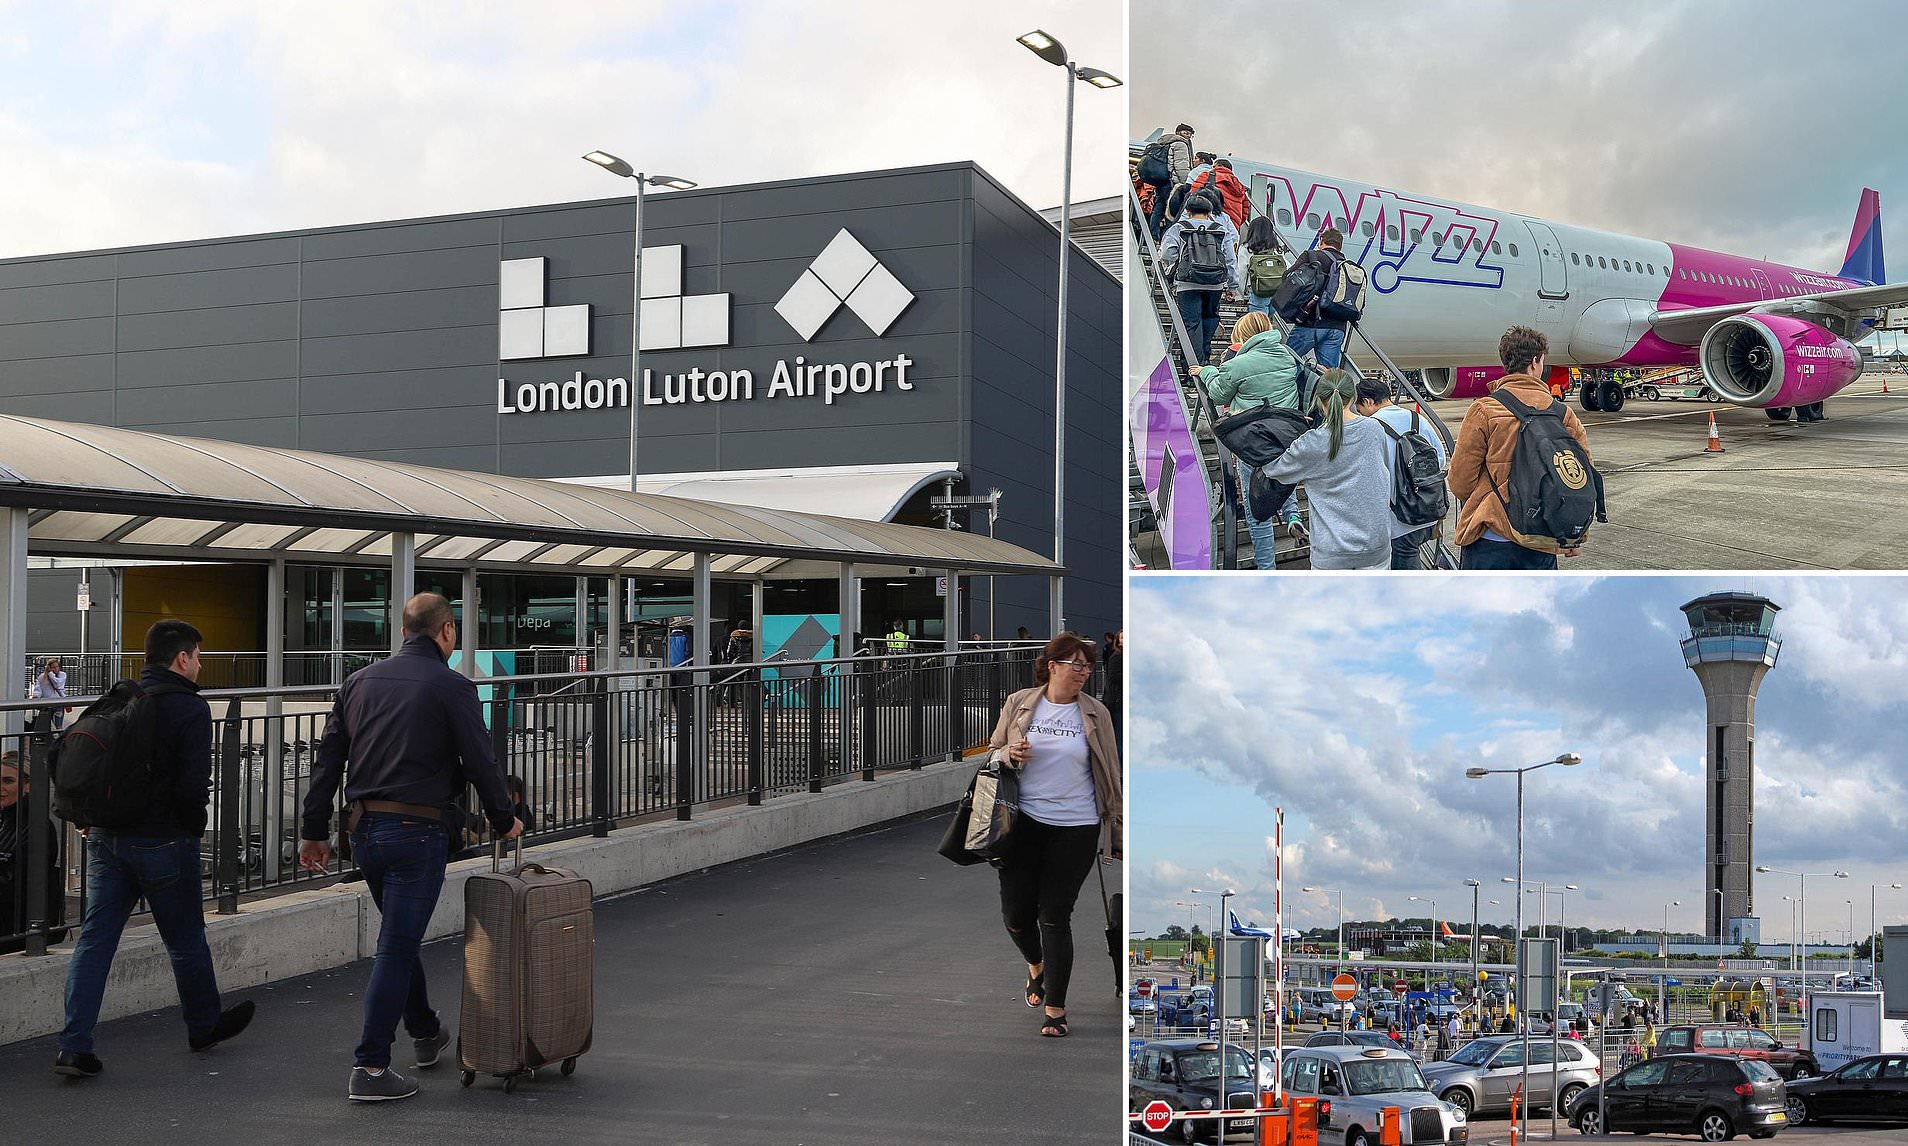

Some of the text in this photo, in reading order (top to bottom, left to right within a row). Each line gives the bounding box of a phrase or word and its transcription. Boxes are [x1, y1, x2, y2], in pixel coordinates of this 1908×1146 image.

[1796, 342, 1844, 359] wizzair.com
[498, 353, 913, 414] London Luton Airport
[1147, 1112, 1169, 1121] STOP
